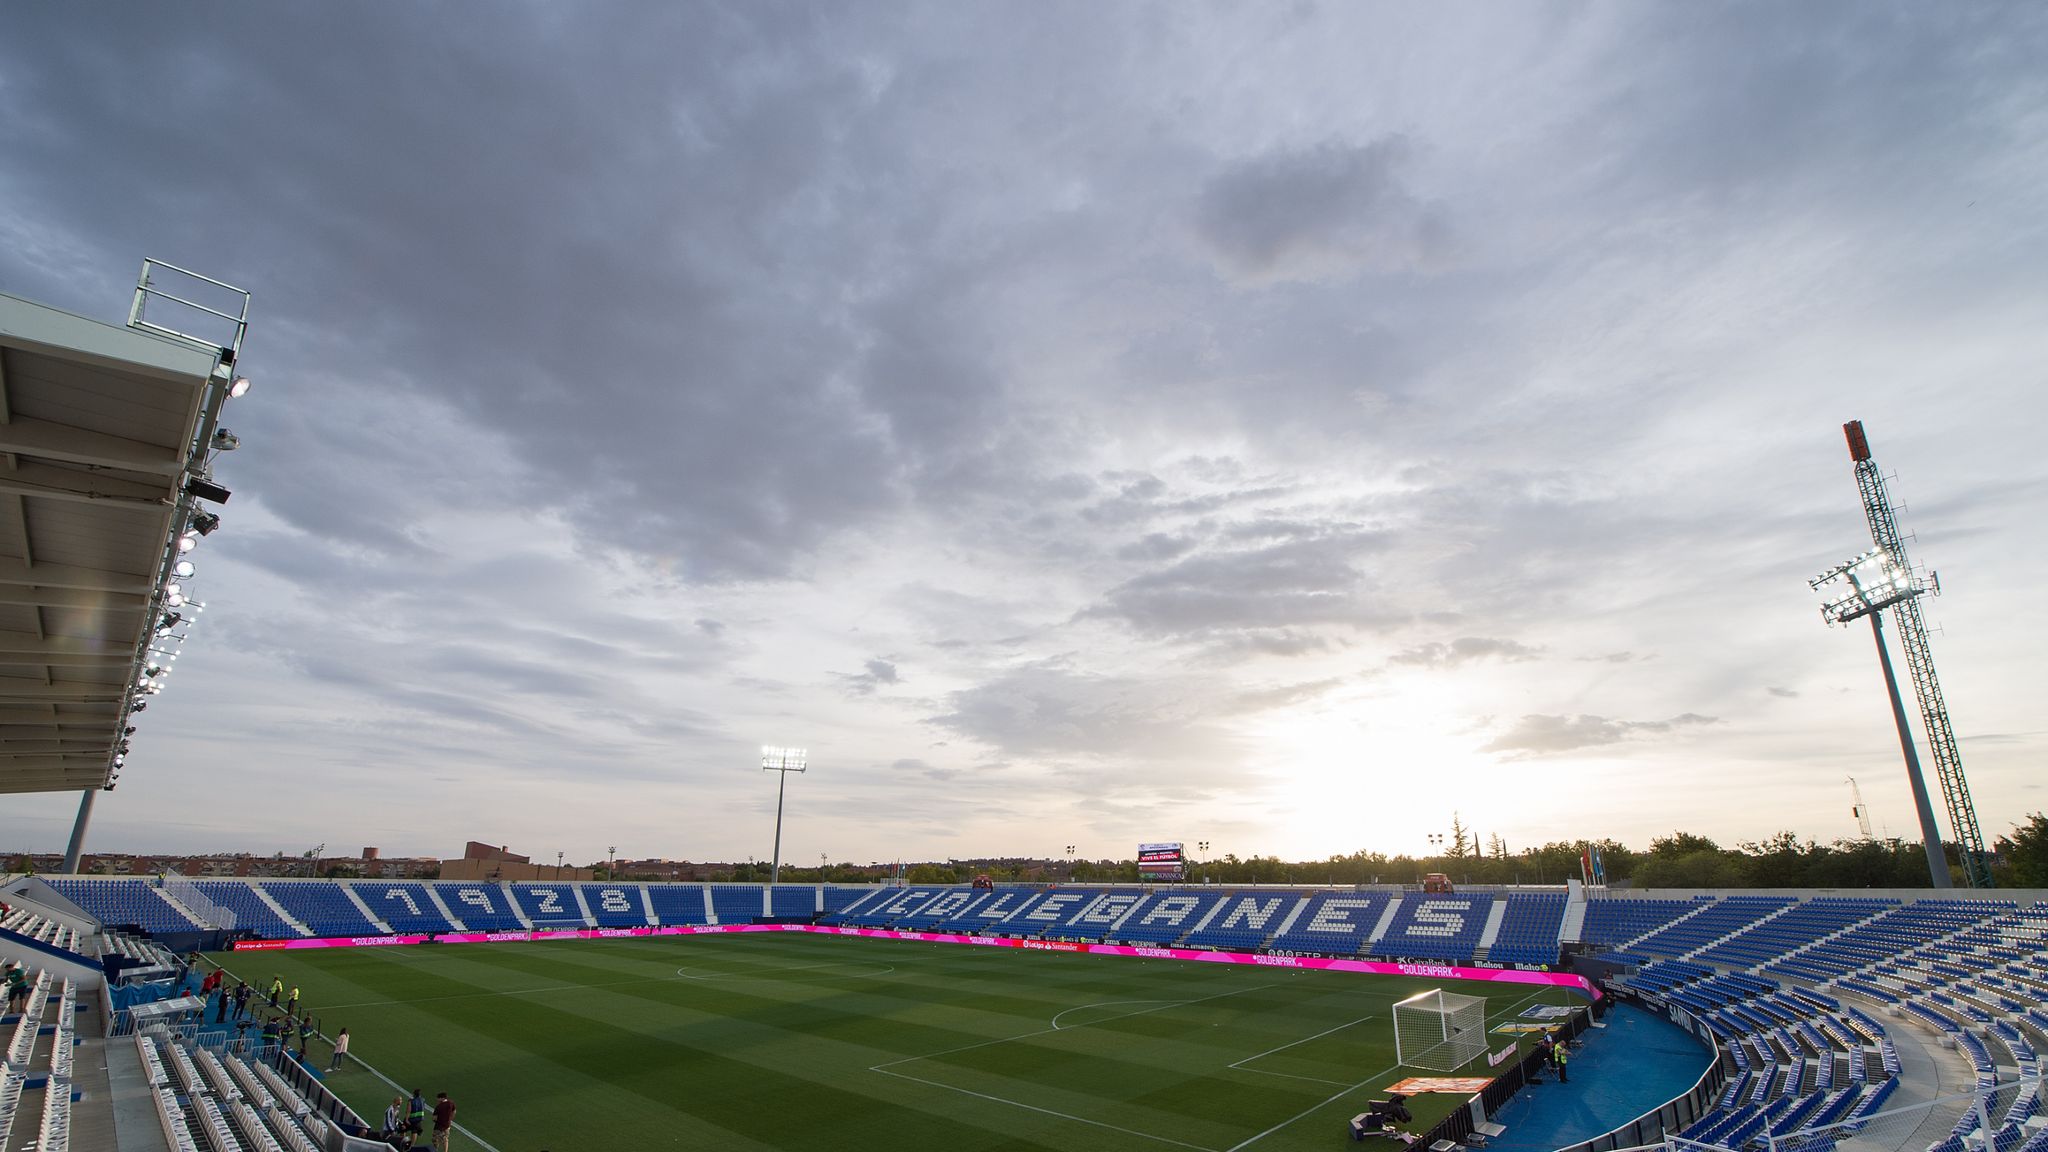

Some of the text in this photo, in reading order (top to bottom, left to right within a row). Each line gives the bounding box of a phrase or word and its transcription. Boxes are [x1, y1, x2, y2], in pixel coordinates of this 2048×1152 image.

[1051, 942, 1078, 951] Santander
[1474, 960, 1504, 970] Mahou
[1515, 962, 1546, 971] Maho
